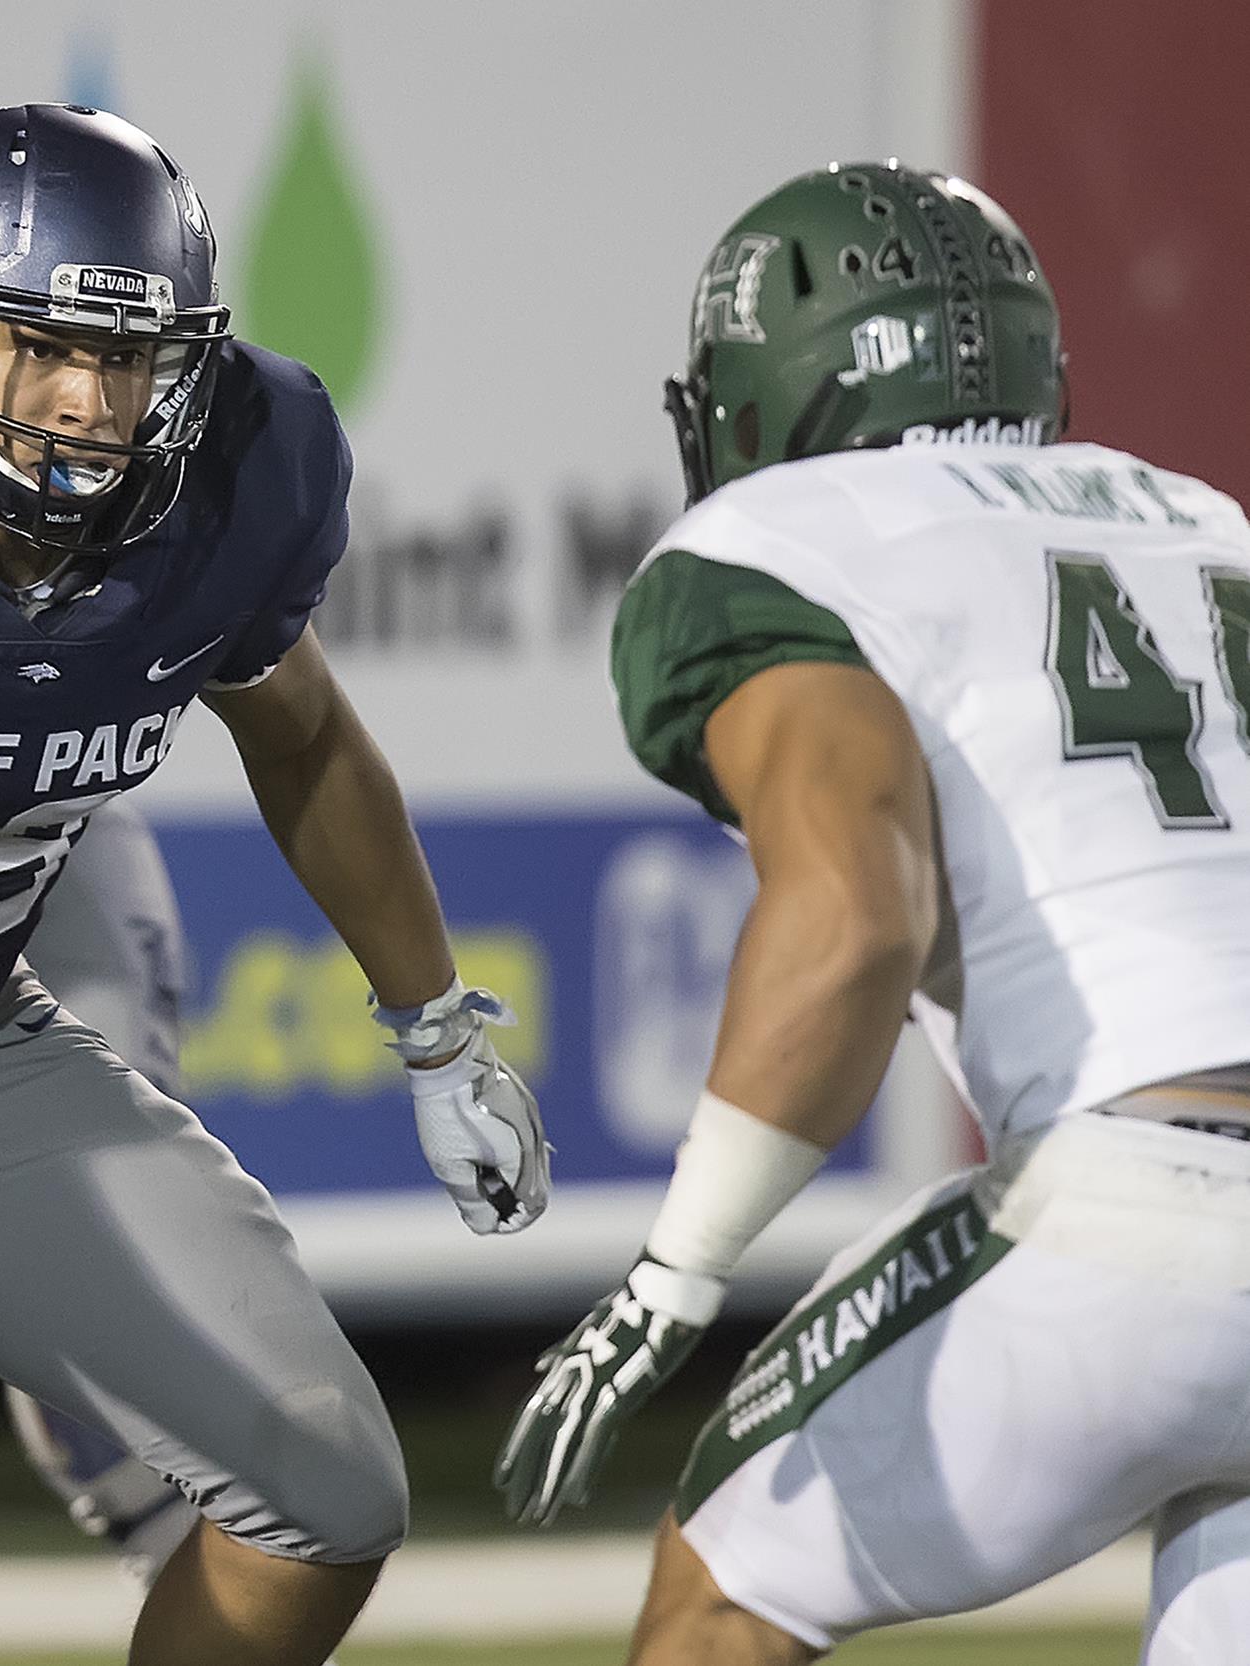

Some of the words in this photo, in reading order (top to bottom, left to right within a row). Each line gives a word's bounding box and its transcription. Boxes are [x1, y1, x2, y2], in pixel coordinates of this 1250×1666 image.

[82, 270, 145, 294] NEVADA
[155, 358, 207, 421] Ridde
[1044, 548, 1250, 832] 4
[796, 1210, 979, 1387] HAWAII
